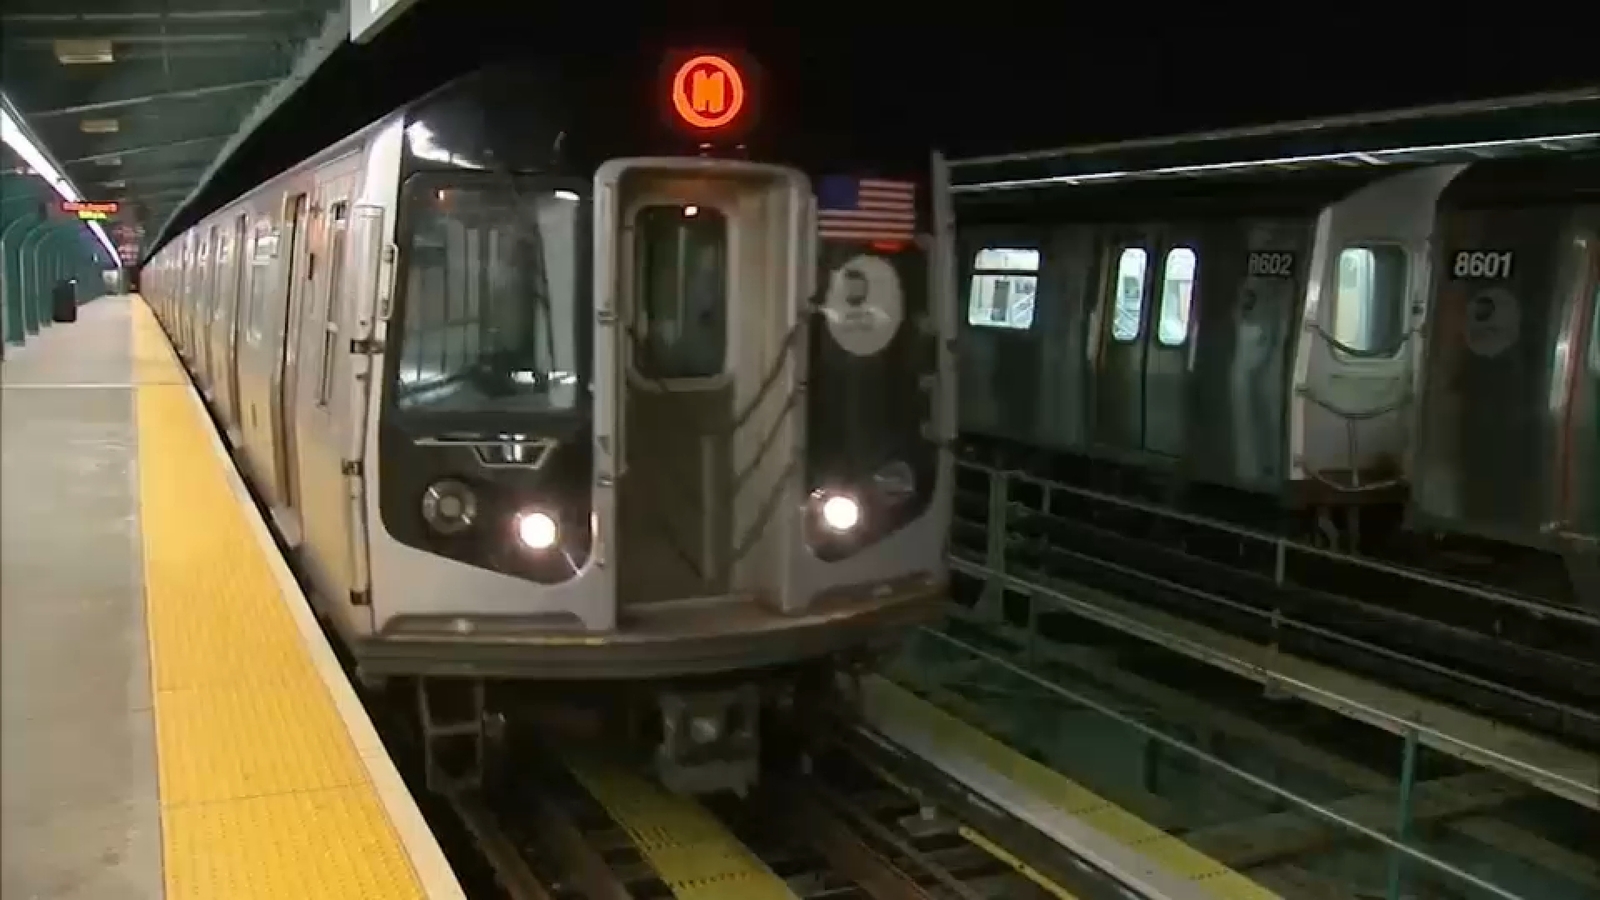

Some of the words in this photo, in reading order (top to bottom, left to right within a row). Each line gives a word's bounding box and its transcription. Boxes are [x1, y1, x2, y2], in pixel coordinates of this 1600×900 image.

[692, 70, 724, 113] M
[1249, 252, 1292, 275] 8602
[1454, 251, 1512, 277] 8601
